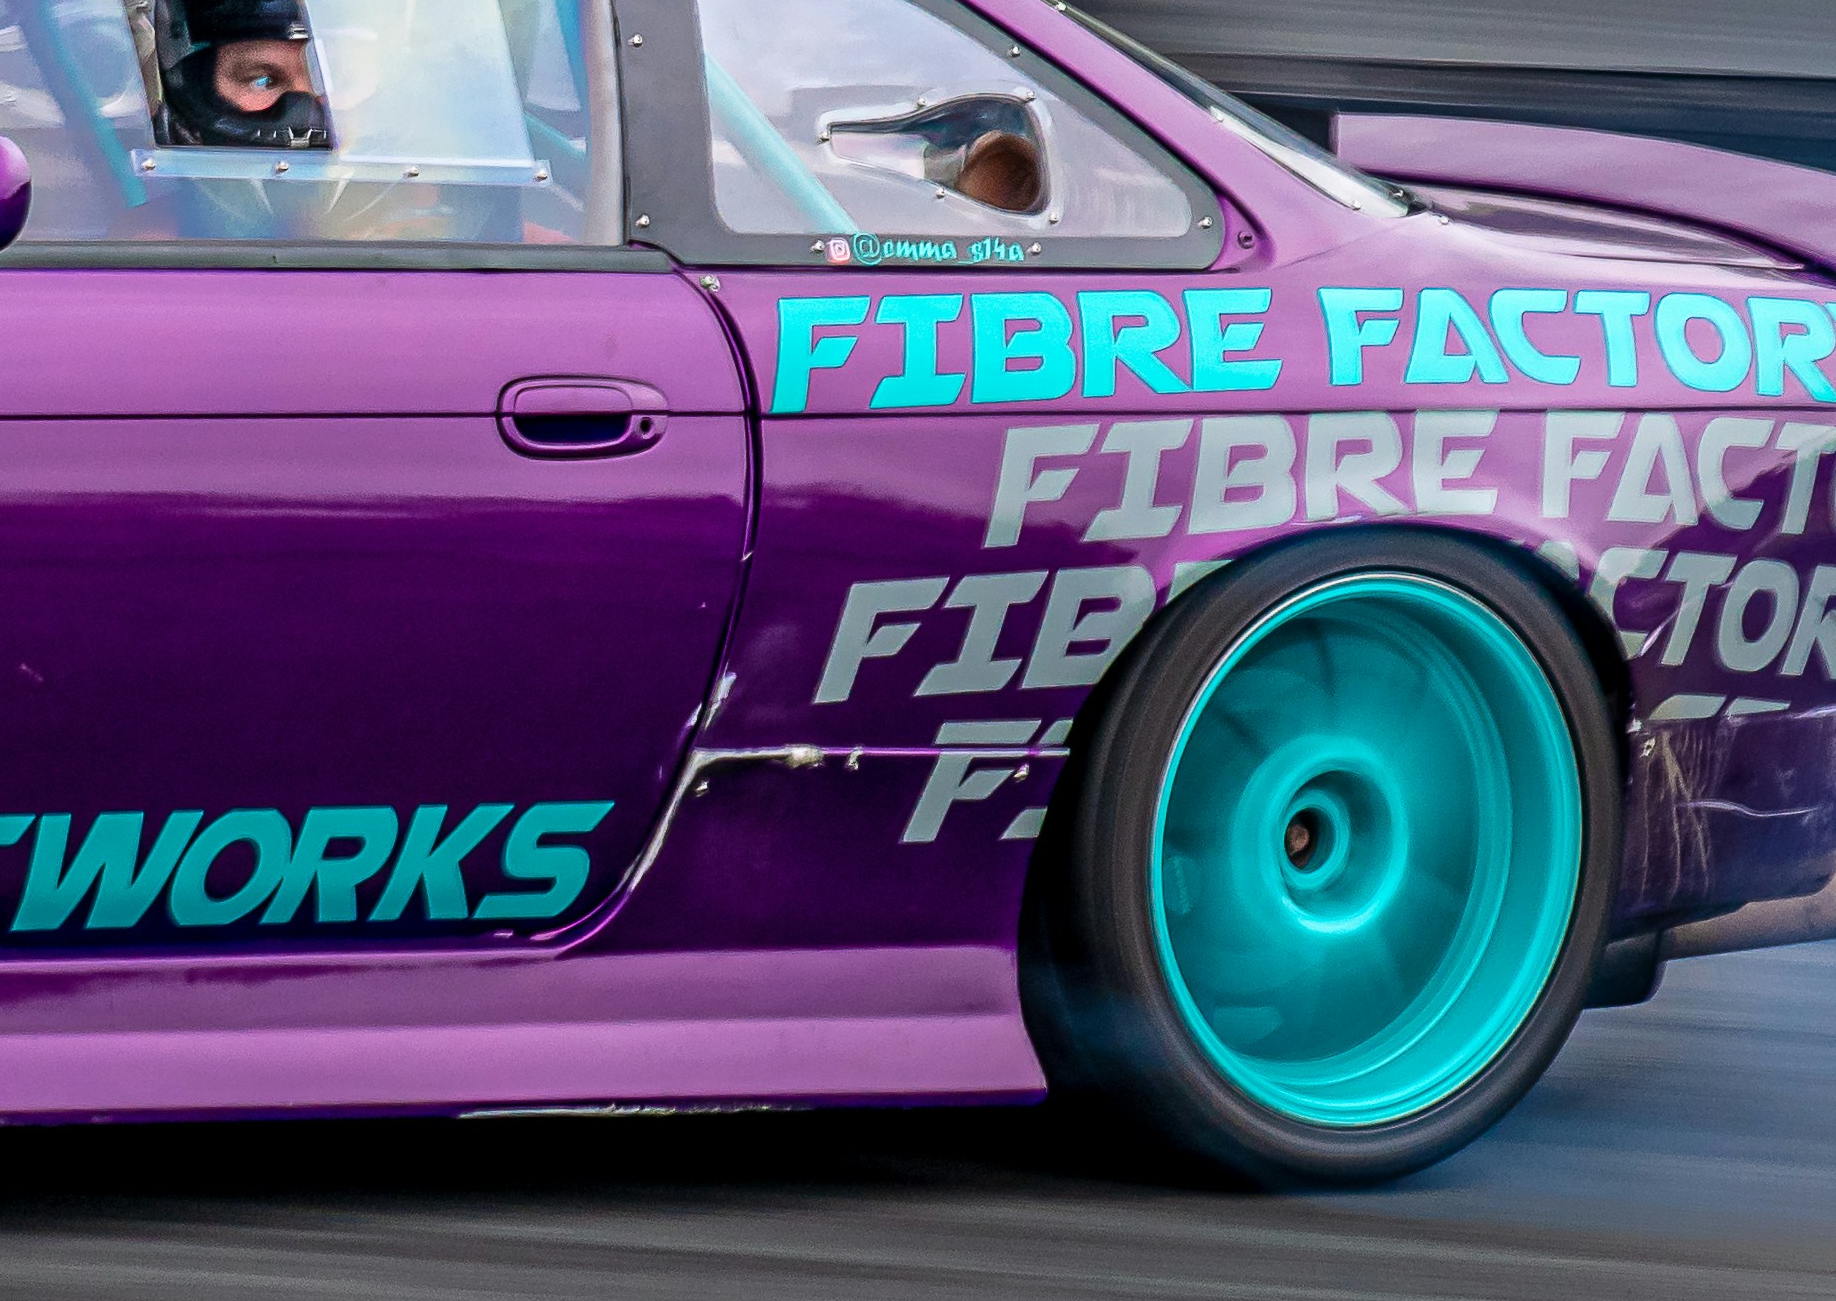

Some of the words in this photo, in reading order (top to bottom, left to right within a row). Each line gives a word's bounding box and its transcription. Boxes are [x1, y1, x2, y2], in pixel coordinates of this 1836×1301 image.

[852, 231, 1026, 266] @emma_s14a
[771, 288, 1283, 413] FIBRE
[983, 409, 1500, 549] FIBRE
[814, 560, 1234, 705] FIB
